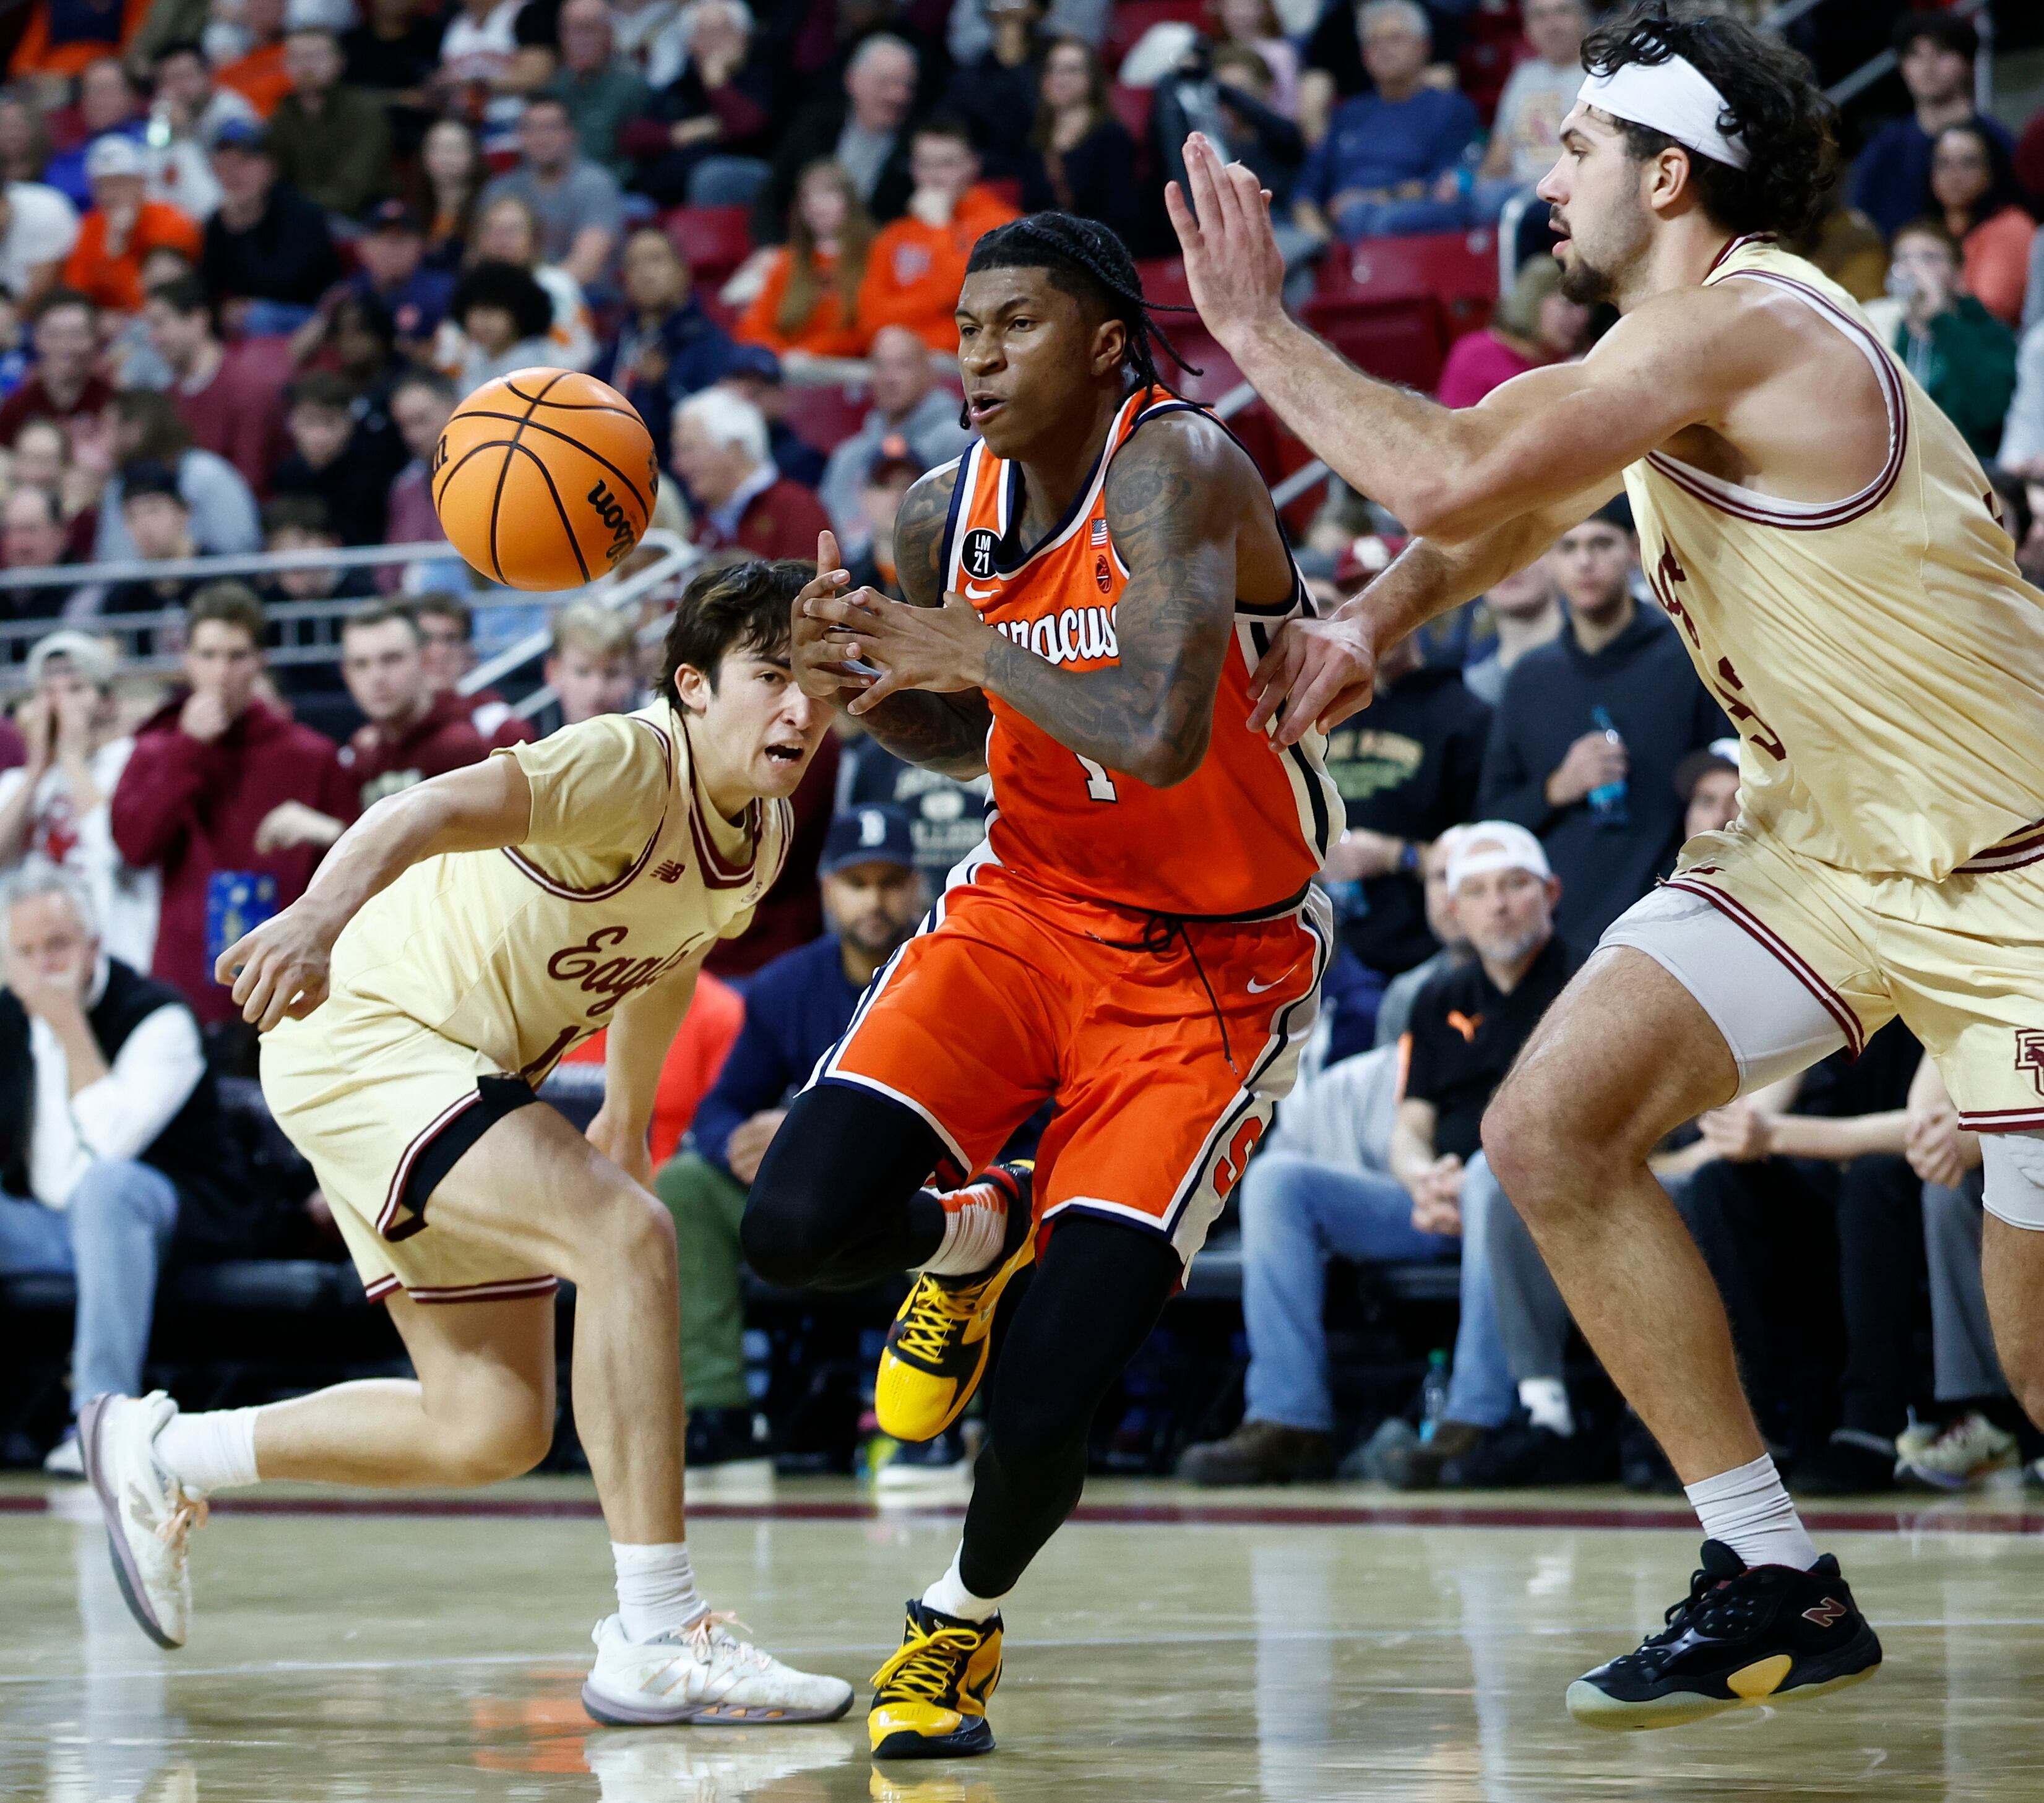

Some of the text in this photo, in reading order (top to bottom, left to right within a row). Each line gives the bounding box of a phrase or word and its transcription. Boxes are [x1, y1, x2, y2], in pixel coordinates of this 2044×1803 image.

[587, 479, 636, 572] lson
[975, 534, 991, 551] LM
[973, 551, 990, 574] 21
[977, 603, 1119, 666] racus
